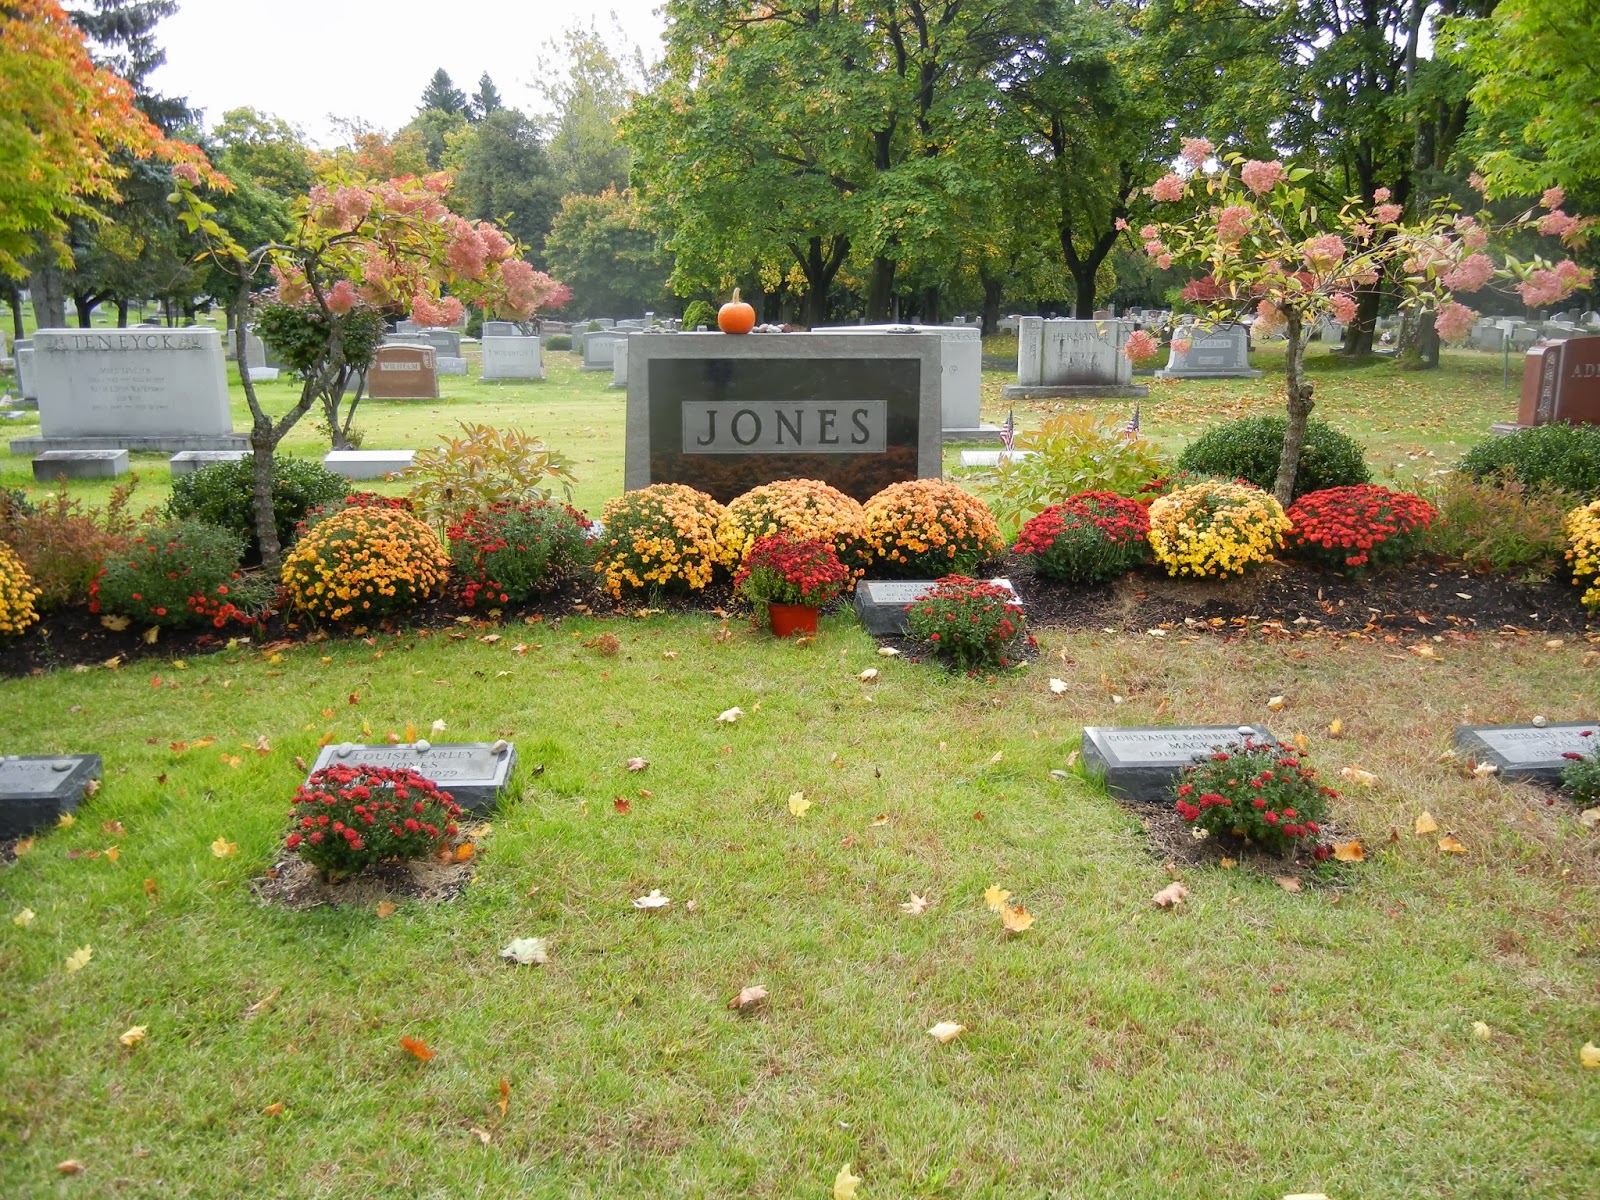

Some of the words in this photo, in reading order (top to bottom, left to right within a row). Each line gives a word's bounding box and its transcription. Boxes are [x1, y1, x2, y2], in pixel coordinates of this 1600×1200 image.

[72, 335, 112, 350] TEN
[118, 335, 174, 350] EYCK
[696, 407, 870, 446] JONES
[1108, 734, 1179, 742] CONSTANCE
[1169, 742, 1212, 750] MACK
[353, 752, 412, 761] LOUISE
[419, 750, 477, 759] FARLEY
[390, 761, 439, 769] JONES
[429, 769, 458, 778] 1979
